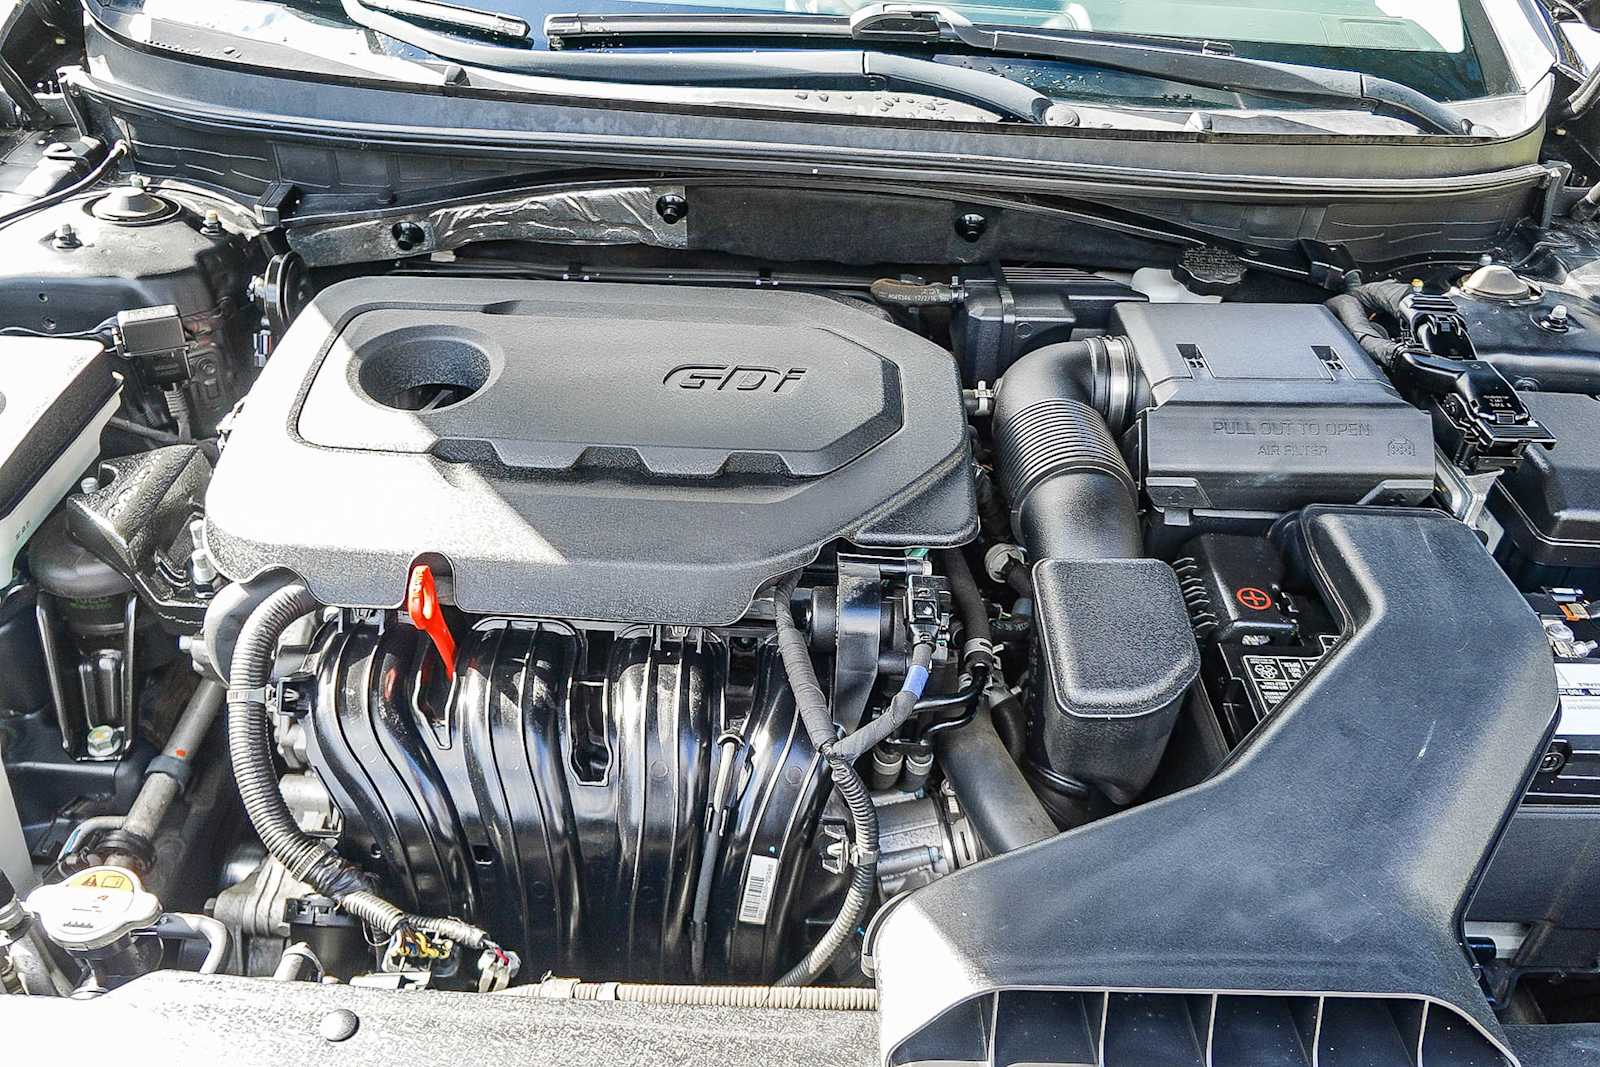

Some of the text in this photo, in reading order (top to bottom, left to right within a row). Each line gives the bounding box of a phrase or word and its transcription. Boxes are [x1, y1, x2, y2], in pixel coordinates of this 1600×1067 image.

[1213, 418, 1371, 437] PULL OUT TO OPEN
[1257, 445, 1329, 457] AIR FILTER
